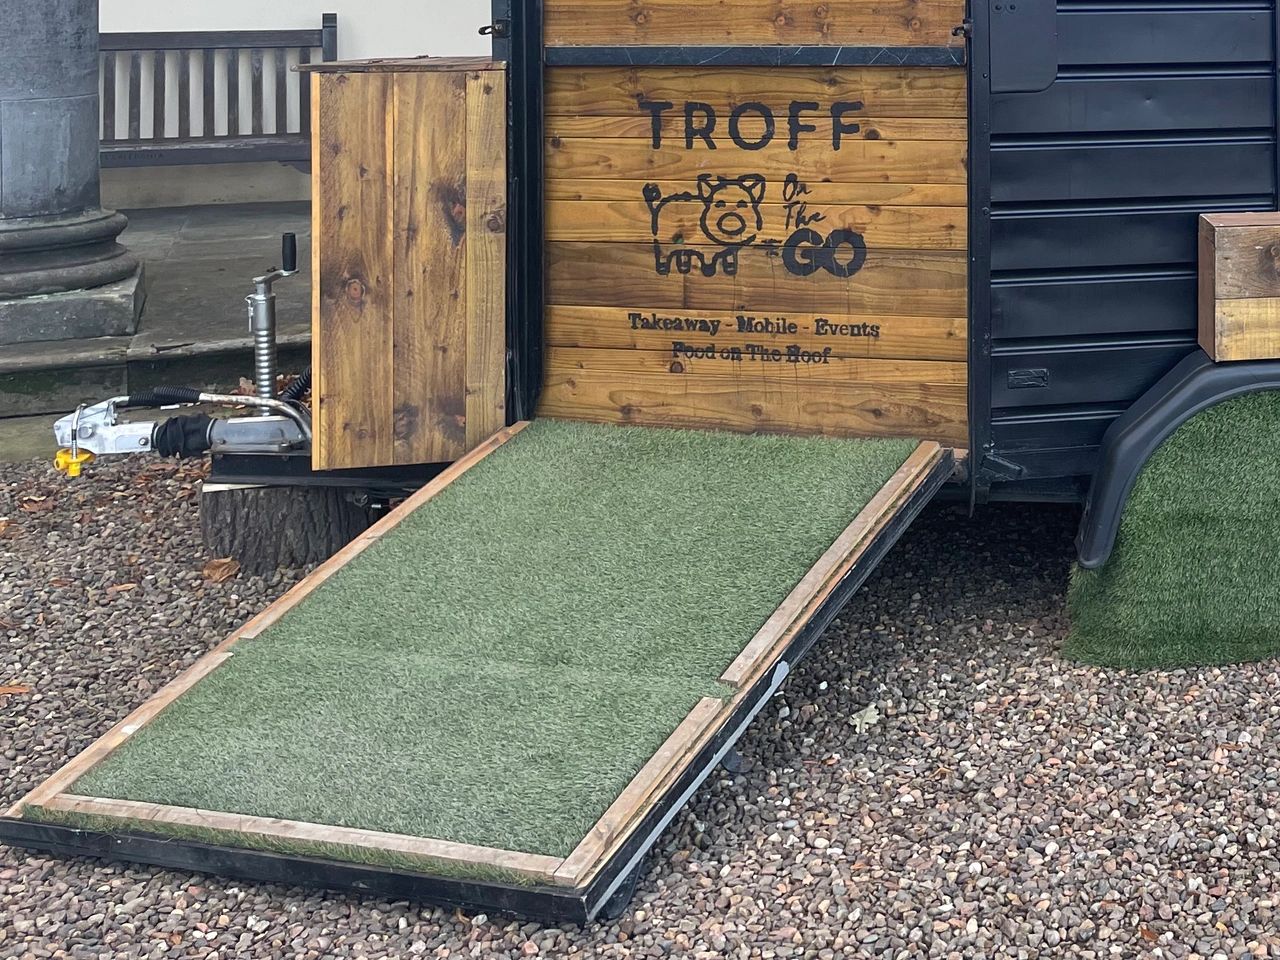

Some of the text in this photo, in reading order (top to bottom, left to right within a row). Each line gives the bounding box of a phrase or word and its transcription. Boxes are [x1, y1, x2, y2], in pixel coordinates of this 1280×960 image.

[638, 100, 864, 151] TROFF
[782, 173, 812, 202] On
[782, 202, 827, 230] The
[782, 228, 867, 278] GO
[628, 312, 721, 336] Takeaway
[736, 316, 797, 334] Mobile
[814, 318, 880, 338] Events
[672, 341, 832, 364] Food on The Hoof
